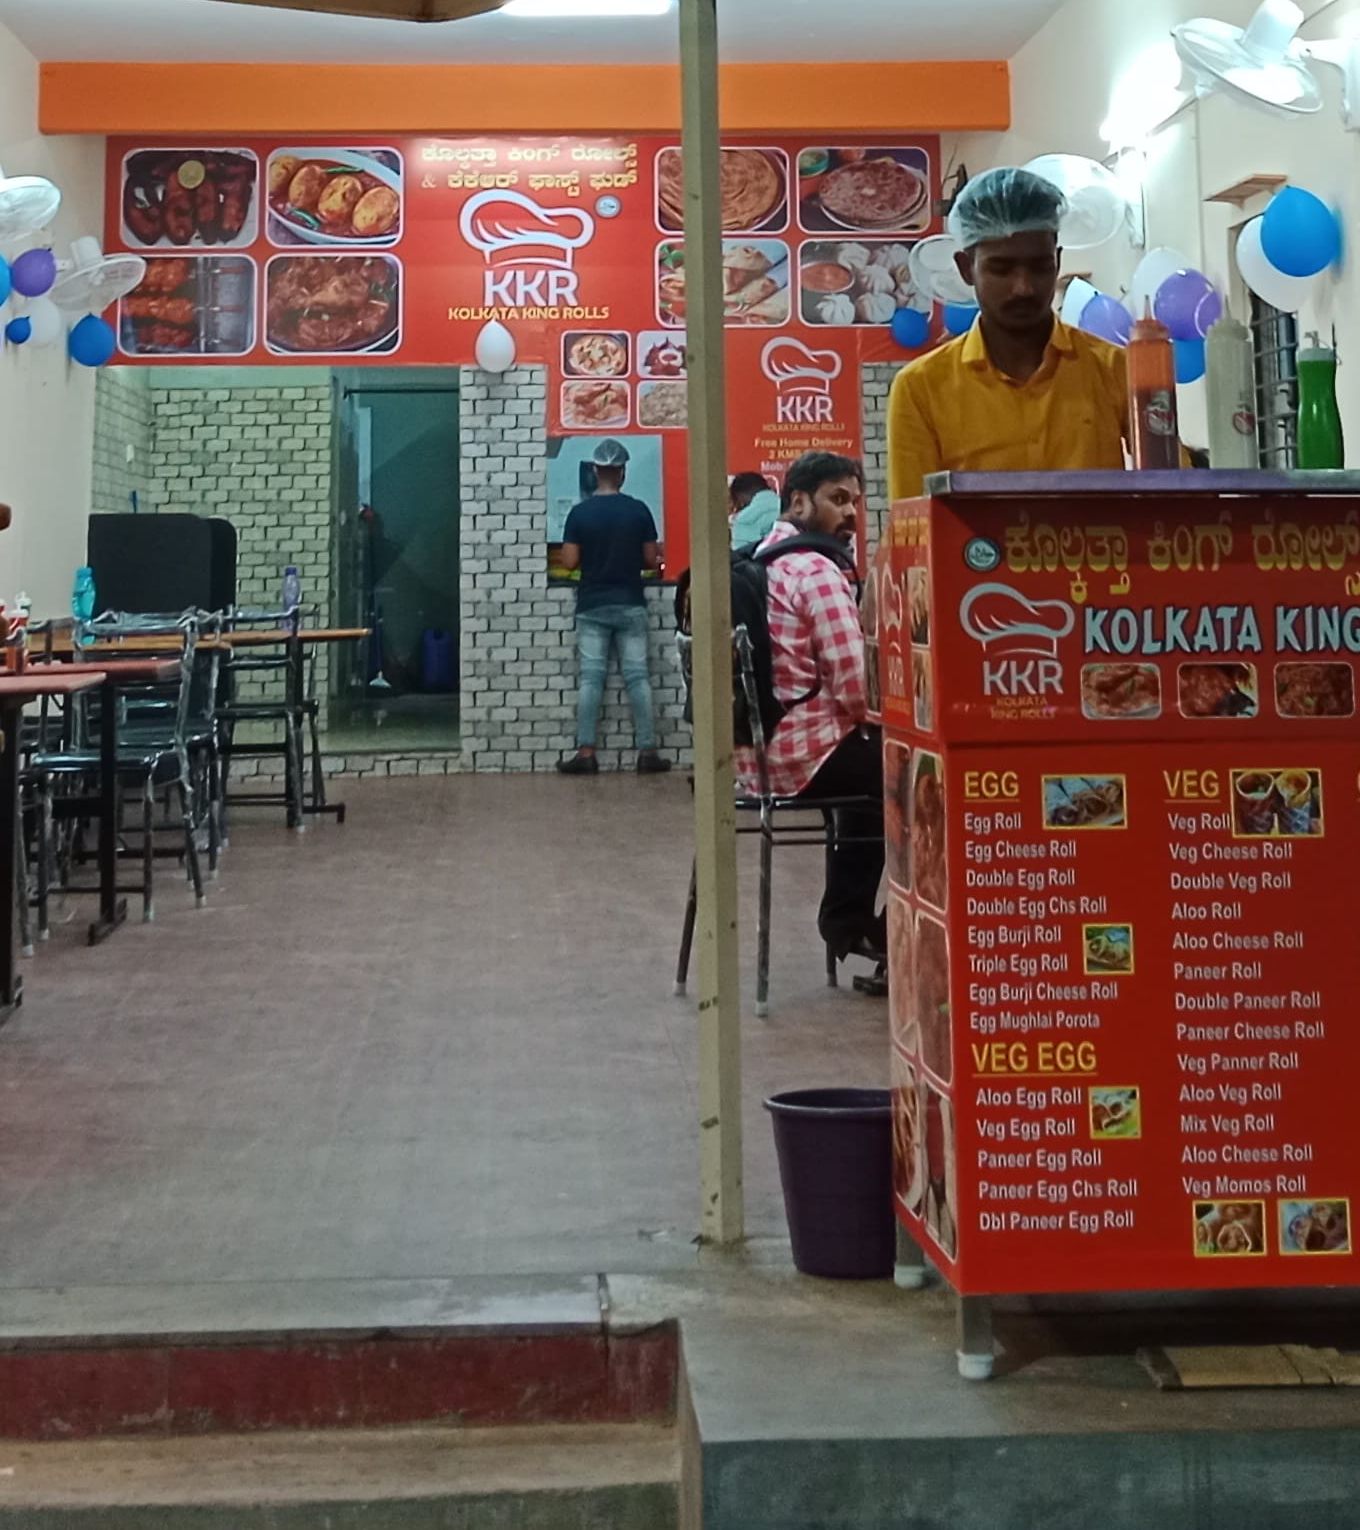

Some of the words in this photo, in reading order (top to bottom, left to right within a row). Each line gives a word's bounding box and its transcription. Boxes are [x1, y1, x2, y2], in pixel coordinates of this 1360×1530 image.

[484, 270, 578, 306] KKR
[448, 307, 518, 320] KOLKATA
[523, 307, 559, 319] KING
[563, 307, 609, 319] ROLLS
[777, 396, 833, 423] KKR
[755, 438, 777, 447] Free
[780, 438, 809, 447] Home
[812, 438, 852, 448] Delivery
[1082, 604, 1263, 656] KOLKATA
[983, 660, 1063, 695] KKR
[964, 771, 1019, 798] EGG
[1163, 770, 1220, 798] VEG
[964, 812, 991, 834] Egg
[994, 812, 1022, 830] Roll
[965, 840, 992, 864] Egg
[995, 840, 1046, 858] Cheese
[1050, 840, 1076, 858] Roll
[966, 868, 1014, 887] Double
[1018, 868, 1044, 891] Egg
[1048, 868, 1075, 886] Roll
[967, 897, 1015, 916] Double
[1018, 896, 1046, 920] Egg
[1049, 896, 1076, 914] Chs
[1080, 896, 1107, 914] Roll
[1171, 902, 1208, 920] Aloo
[1211, 902, 1242, 919] Roll
[968, 926, 994, 948] Egg
[998, 925, 1030, 948] Burji
[1034, 924, 1062, 943] Roll
[968, 954, 1006, 976] Triple
[1010, 954, 1038, 977] Egg
[1040, 953, 1068, 972] Roll
[970, 982, 996, 1006] Egg
[1000, 982, 1032, 1006] Burji
[1036, 982, 1087, 1000] Cheese
[1090, 981, 1118, 1000] Roll
[970, 1012, 996, 1034] Egg
[1000, 1010, 1052, 1034] Mughlai
[1056, 1010, 1100, 1028] Porota
[971, 1042, 1028, 1072] VEG
[1038, 1042, 1096, 1071] EGG
